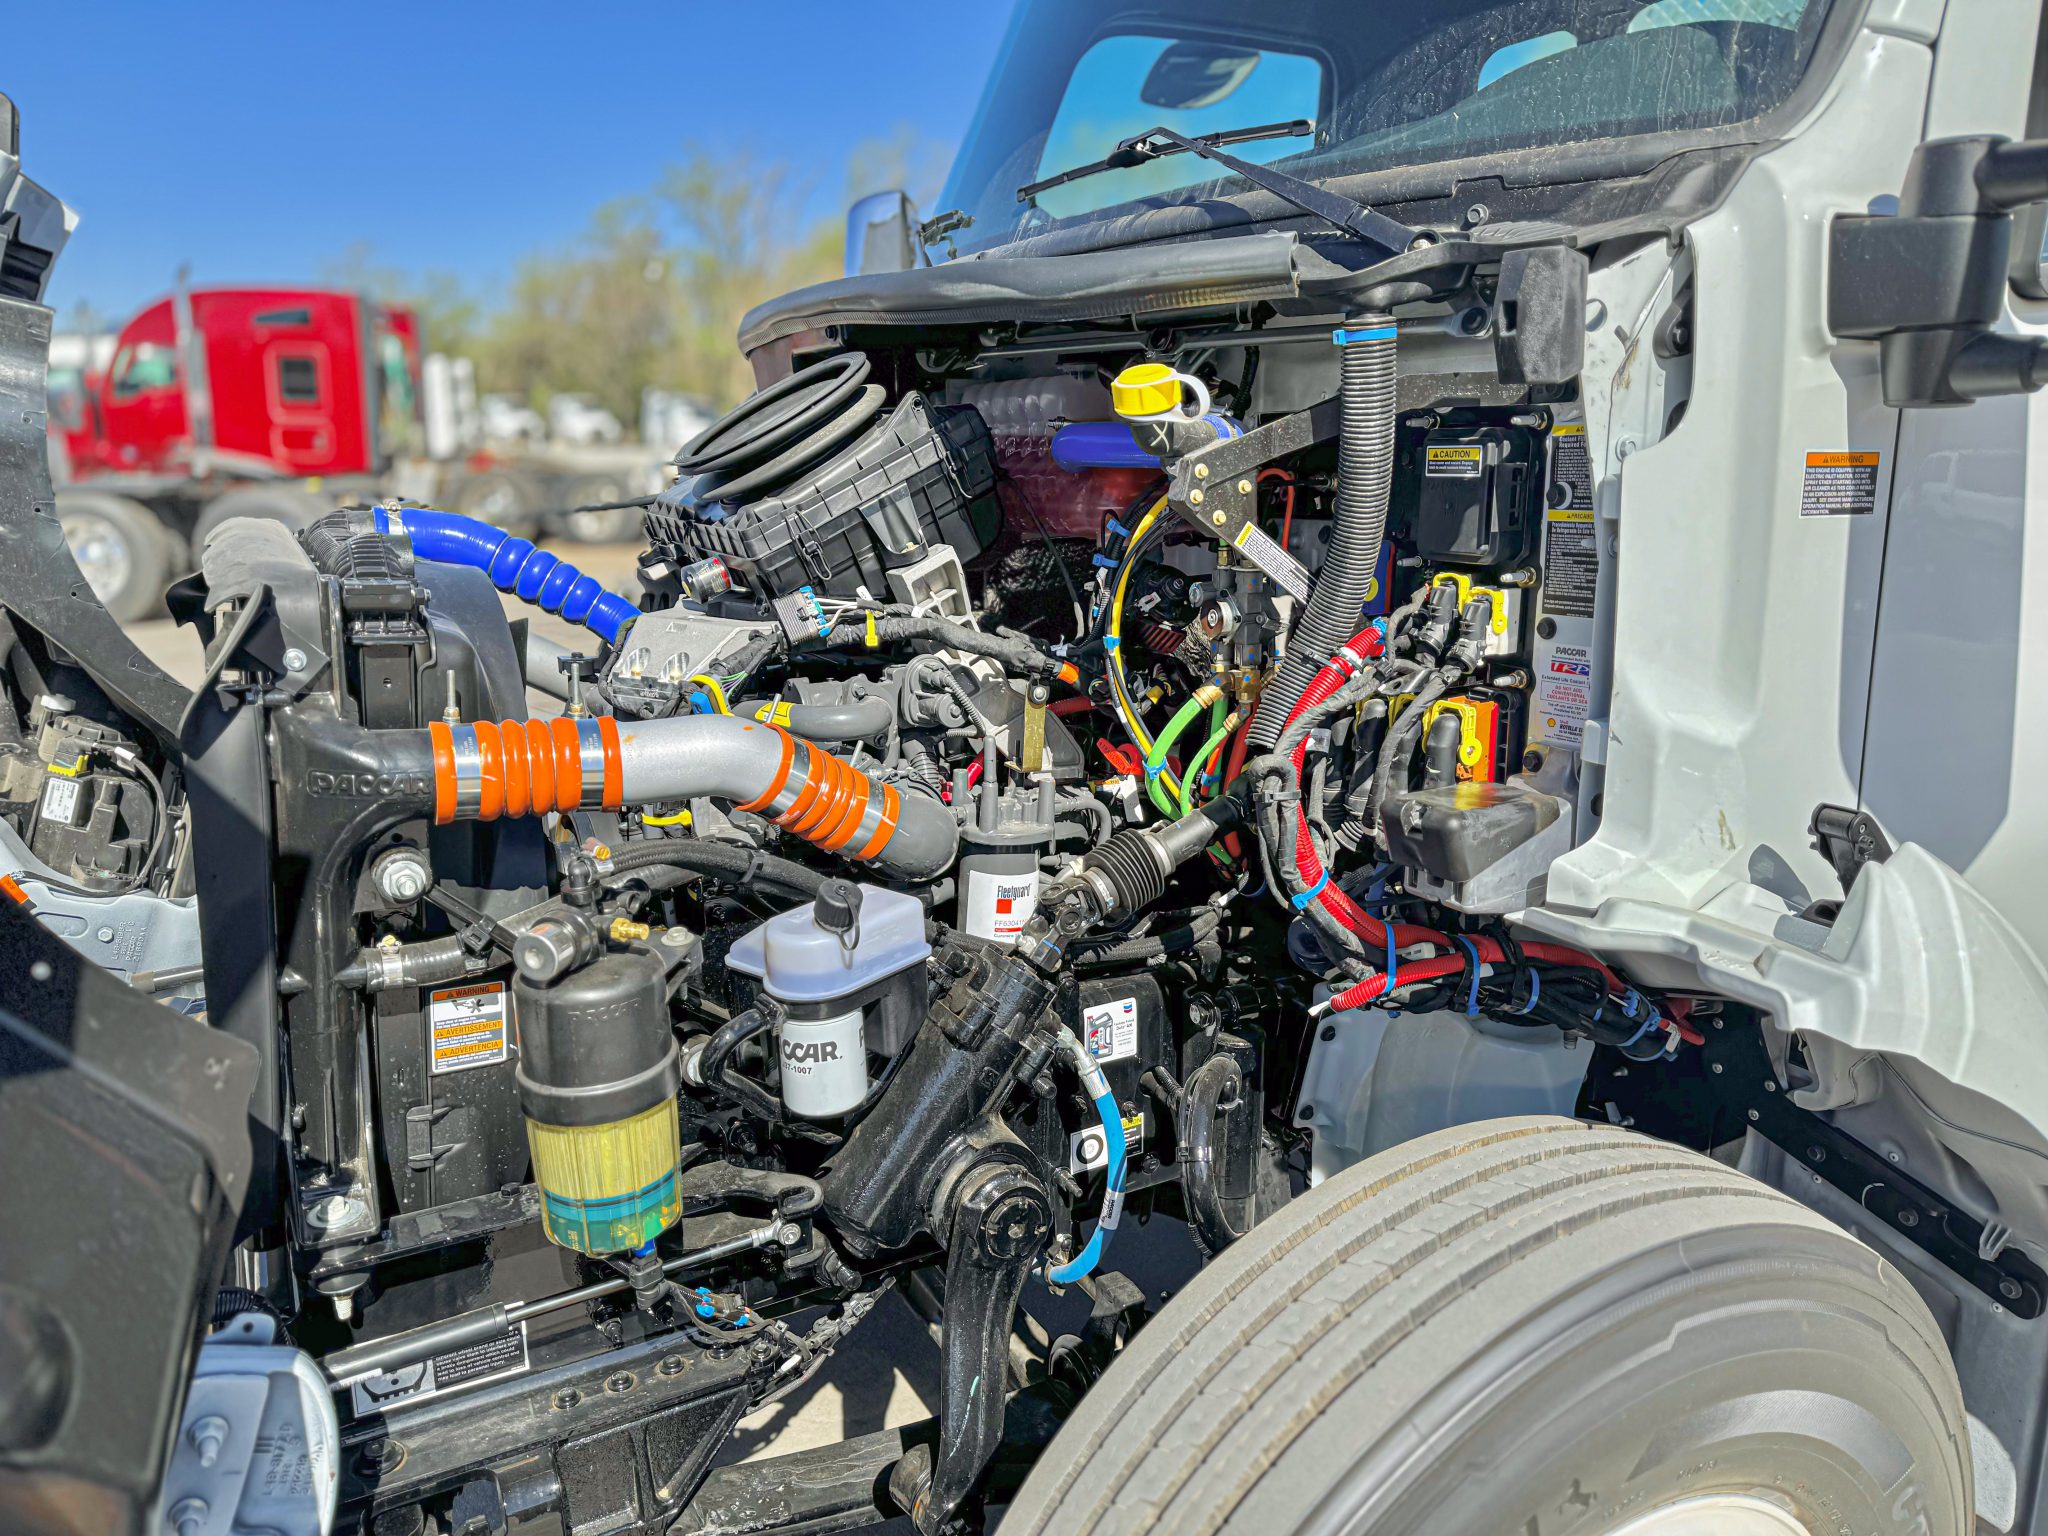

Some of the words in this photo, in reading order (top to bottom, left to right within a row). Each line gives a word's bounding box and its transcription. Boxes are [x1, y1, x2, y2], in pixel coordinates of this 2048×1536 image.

[1440, 450, 1470, 458] CAUTION
[1556, 647, 1587, 657] PACCAR
[1551, 661, 1590, 676] TRP
[1552, 689, 1585, 699] CONVENTIONAL
[310, 771, 431, 796] PACCAR
[997, 884, 1030, 900] Fleetguard
[456, 986, 489, 996] WARNING
[447, 1021, 500, 1035] AVERTISSEMENT
[450, 1041, 498, 1055] ADVERTENCIA
[781, 1039, 838, 1063] CCAR
[486, 1344, 507, 1352] interfere
[473, 1358, 491, 1366] vehicle
[492, 1353, 509, 1361] control
[485, 1350, 500, 1358] which
[468, 1364, 489, 1374] personal
